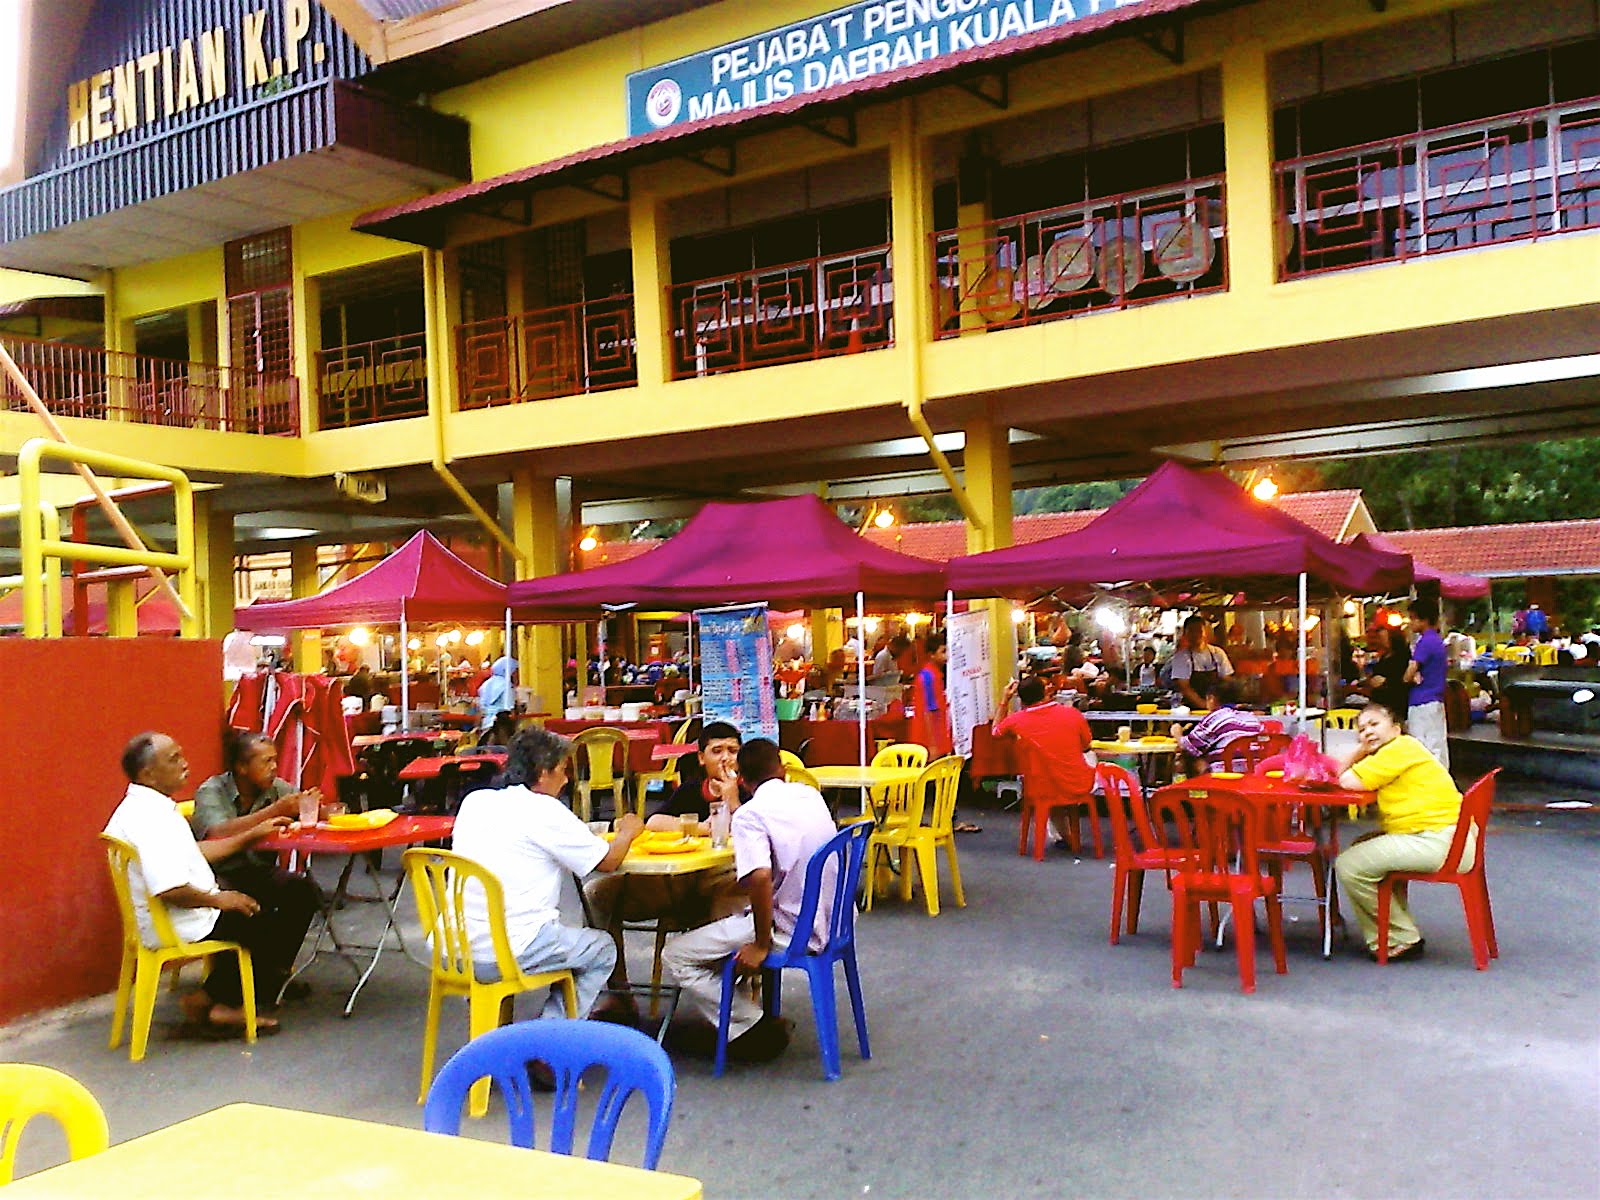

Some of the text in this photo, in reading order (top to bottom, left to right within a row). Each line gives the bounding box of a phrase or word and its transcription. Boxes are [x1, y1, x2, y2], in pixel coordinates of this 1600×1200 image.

[67, 25, 226, 150] HENTIAN
[687, 0, 1076, 122] MAJLIS DAERAH KUALA
[711, 13, 854, 87] PEJABAT
